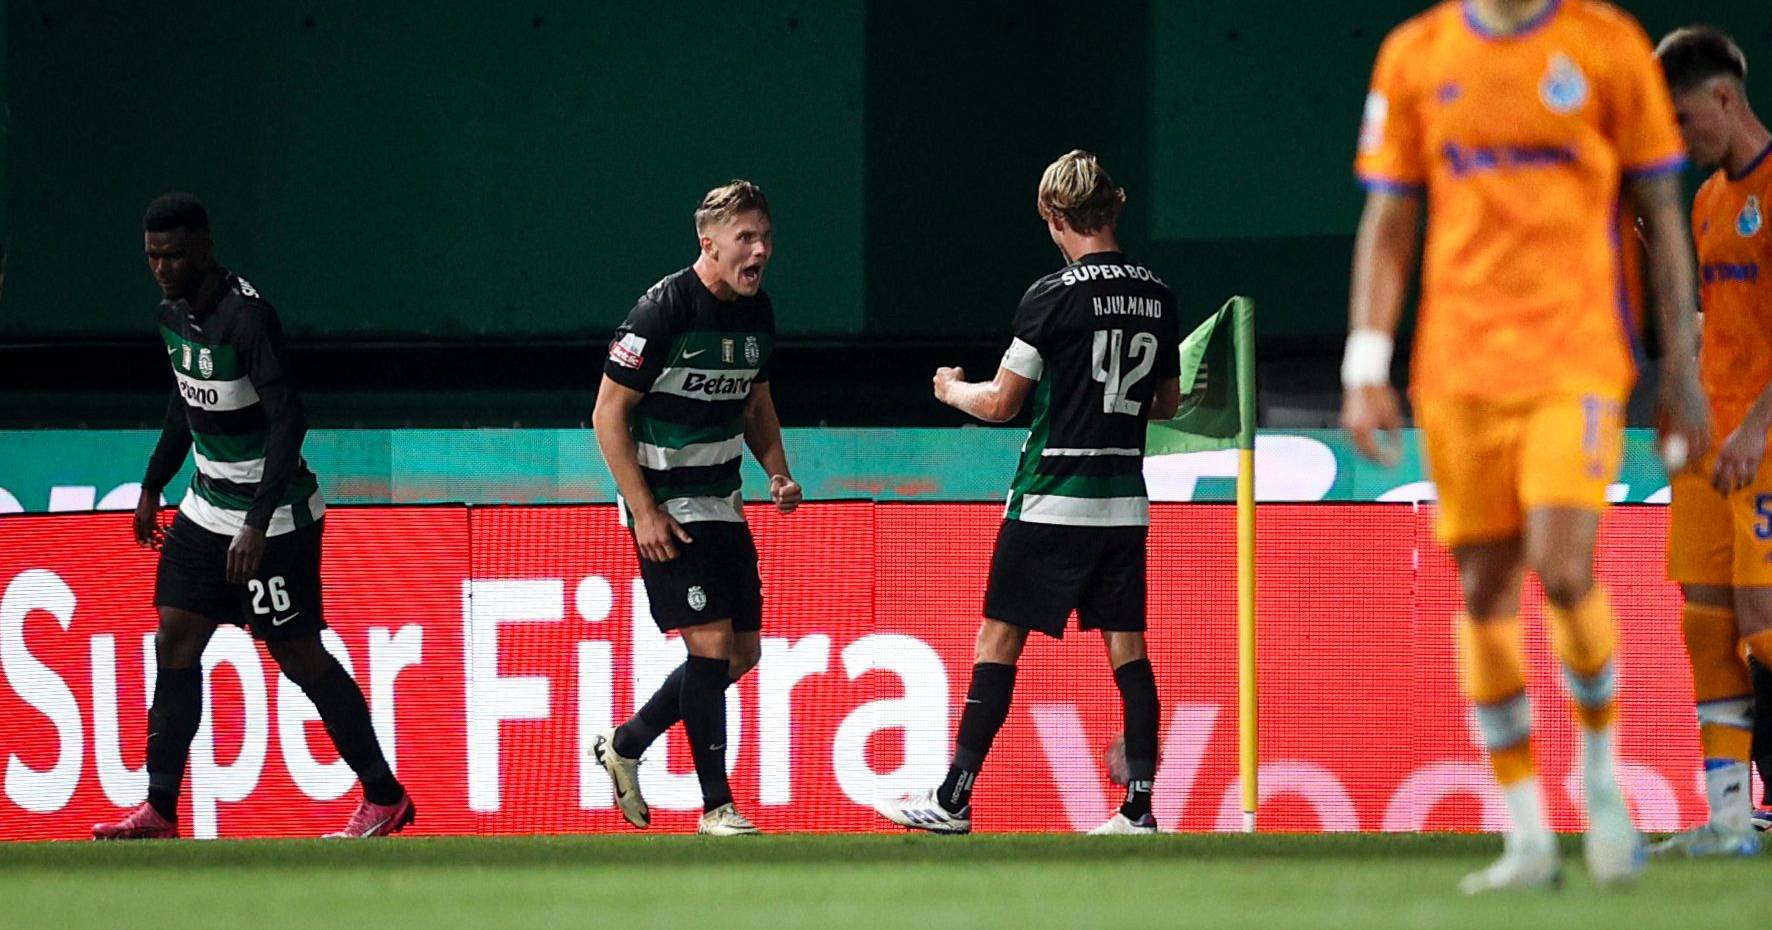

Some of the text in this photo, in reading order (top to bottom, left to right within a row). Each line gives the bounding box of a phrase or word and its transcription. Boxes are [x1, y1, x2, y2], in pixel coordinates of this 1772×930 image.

[1061, 264, 1168, 288] SUPER BOC
[1093, 296, 1162, 318] HJULMAND
[1092, 328, 1159, 417] 42
[248, 576, 291, 615] 26
[0, 568, 424, 838] Super
[461, 575, 949, 813] Fibra
